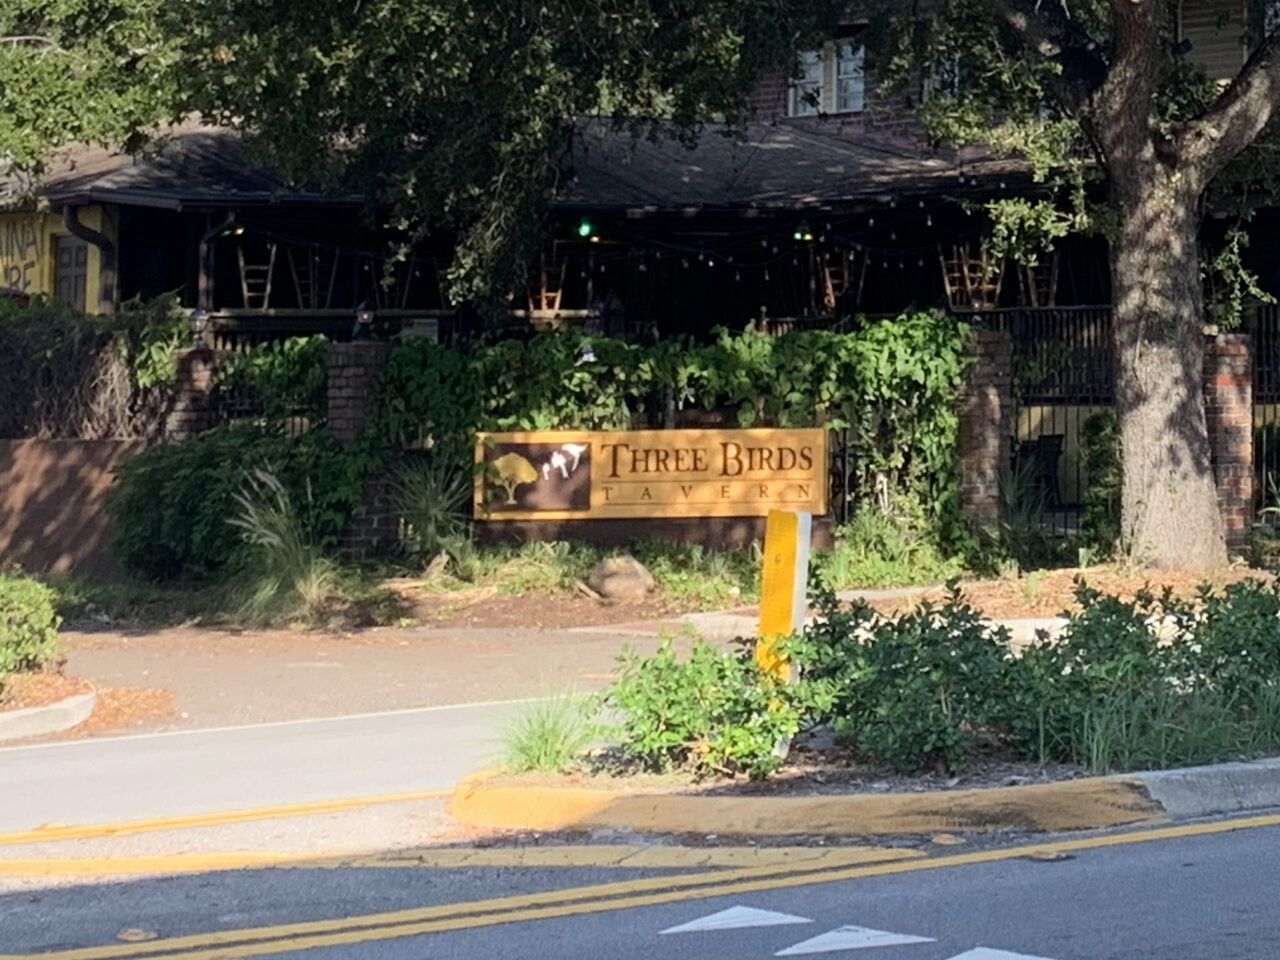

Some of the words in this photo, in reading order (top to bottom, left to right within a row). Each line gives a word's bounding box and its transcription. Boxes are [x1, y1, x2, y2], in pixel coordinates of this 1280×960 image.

[601, 443, 708, 478] THREE
[719, 442, 813, 476] BIRDS
[601, 484, 810, 501] TAVERN
